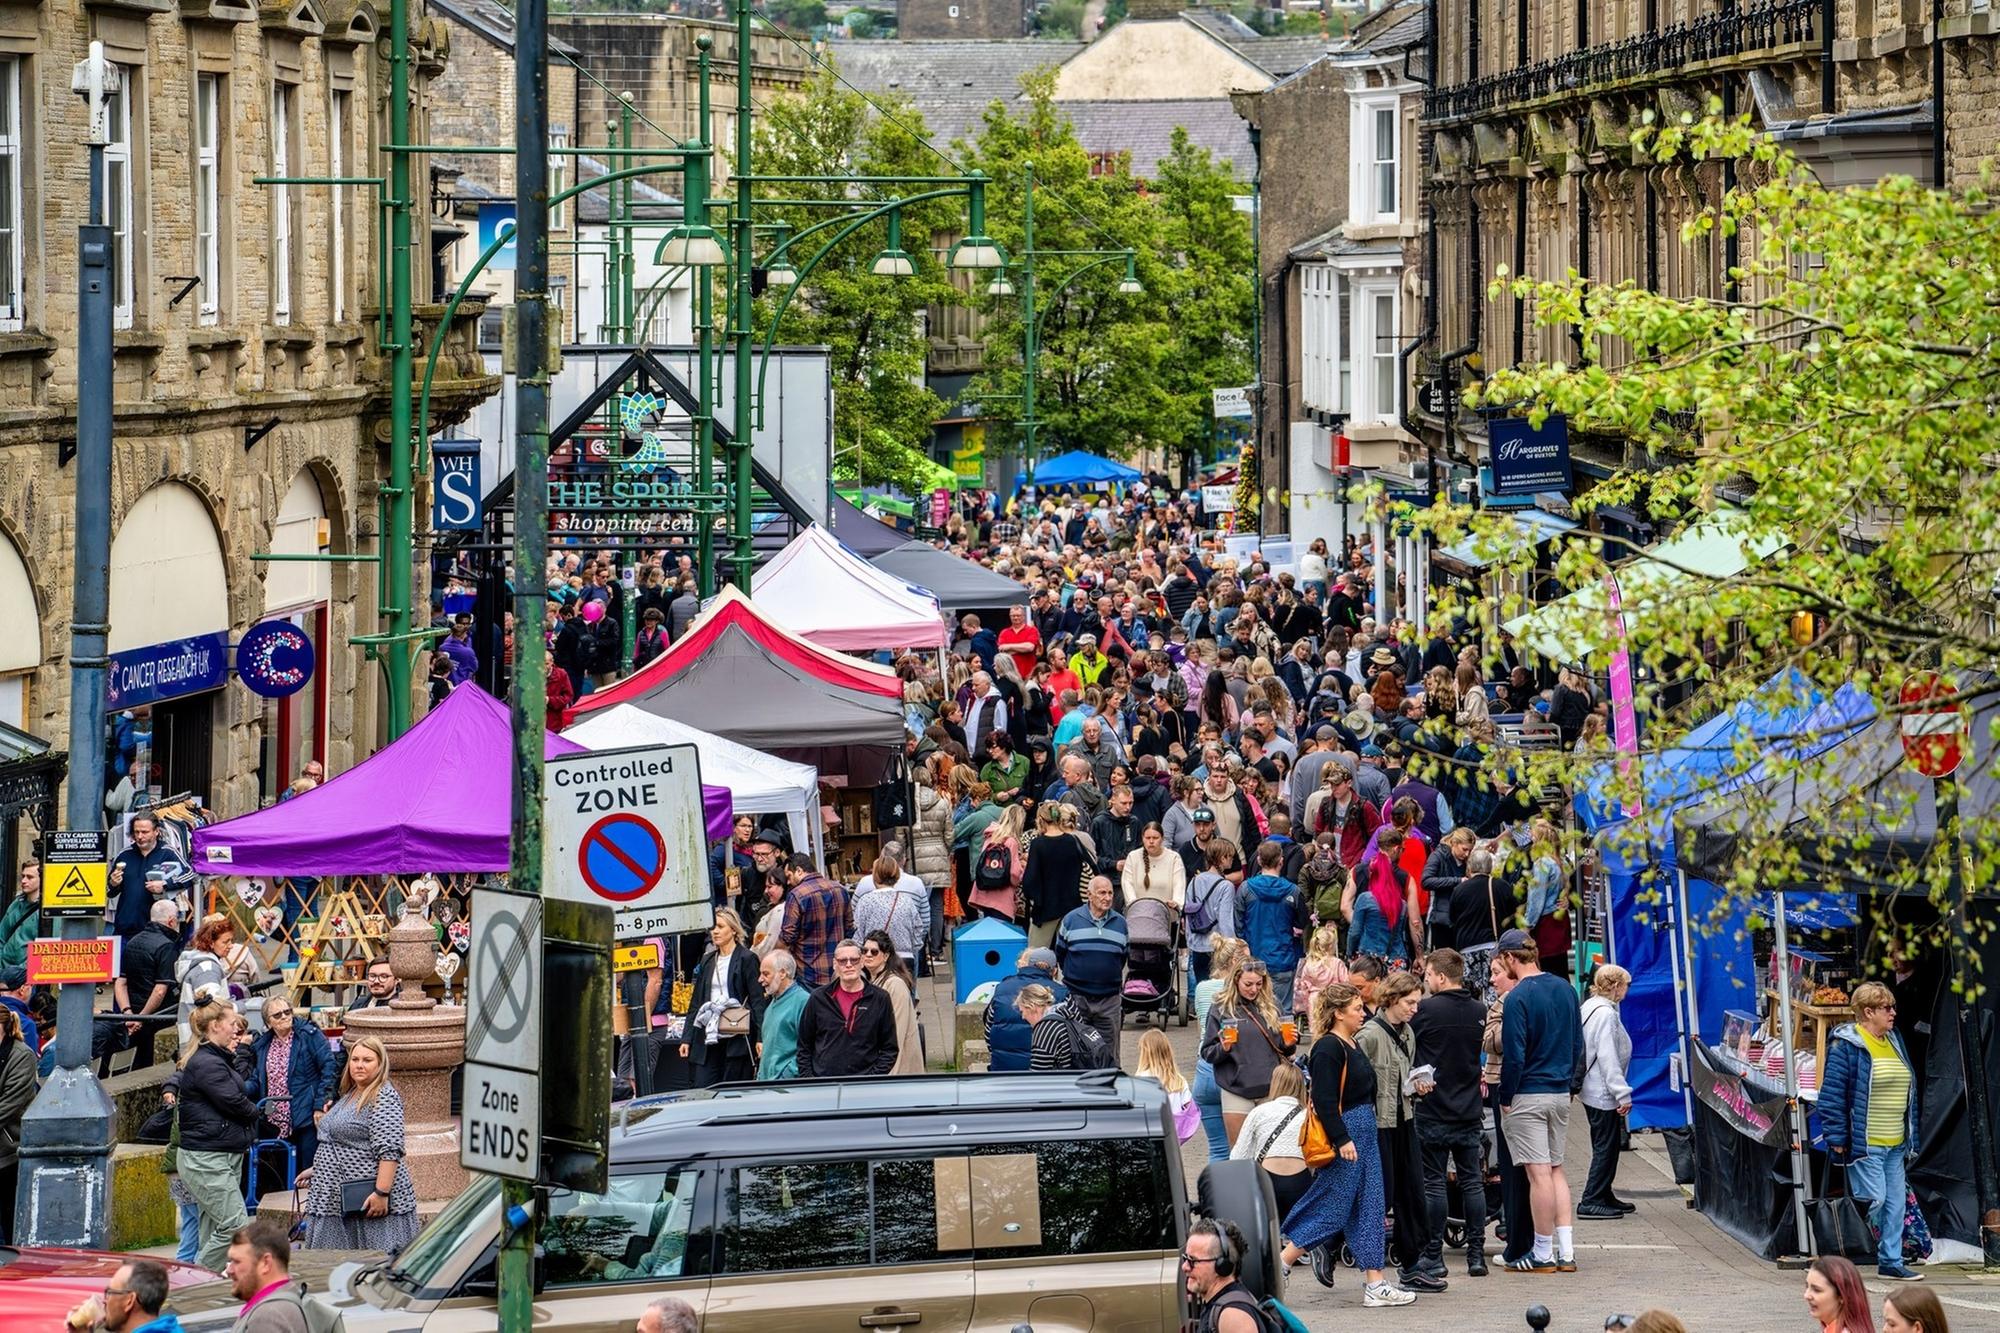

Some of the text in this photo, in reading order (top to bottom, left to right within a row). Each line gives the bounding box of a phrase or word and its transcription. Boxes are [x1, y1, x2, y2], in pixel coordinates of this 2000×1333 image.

[440, 456, 473, 471] WH
[441, 471, 475, 524] S
[558, 513, 651, 534] shopping
[121, 661, 156, 692] CANCER
[157, 652, 199, 683] RESEARCH
[198, 650, 210, 675] UK
[555, 757, 673, 787] Controlled
[576, 783, 658, 814] ZONE
[33, 942, 107, 954] DANDELION
[482, 1081, 519, 1114] Zone
[470, 1118, 529, 1163] ENDS
